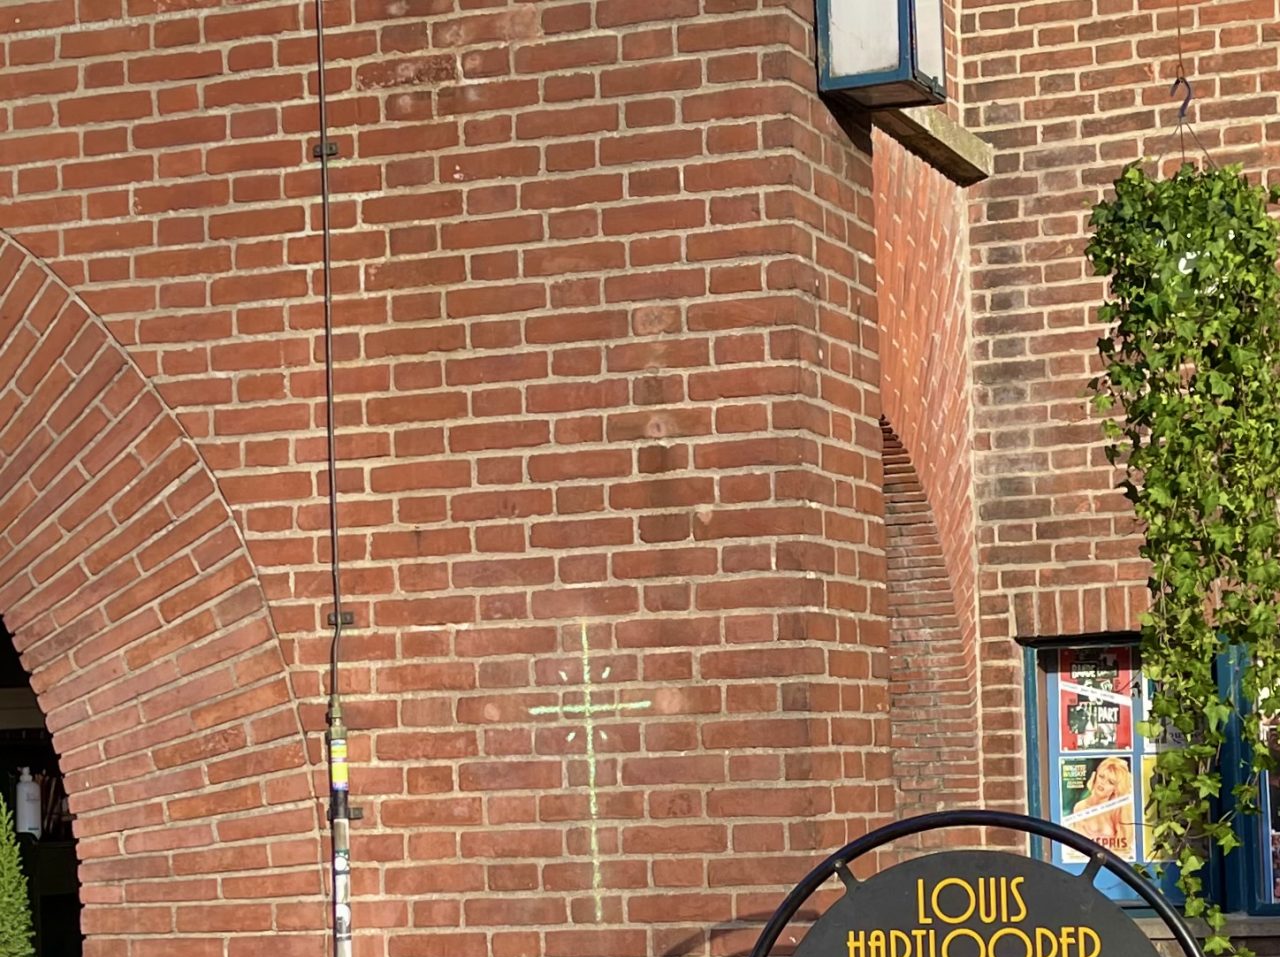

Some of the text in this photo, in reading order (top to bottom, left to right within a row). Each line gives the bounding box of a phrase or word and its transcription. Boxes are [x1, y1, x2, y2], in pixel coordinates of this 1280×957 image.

[1098, 706, 1119, 722] PART
[1092, 837, 1128, 849] EPRIS
[917, 876, 1028, 925] LOUIS
